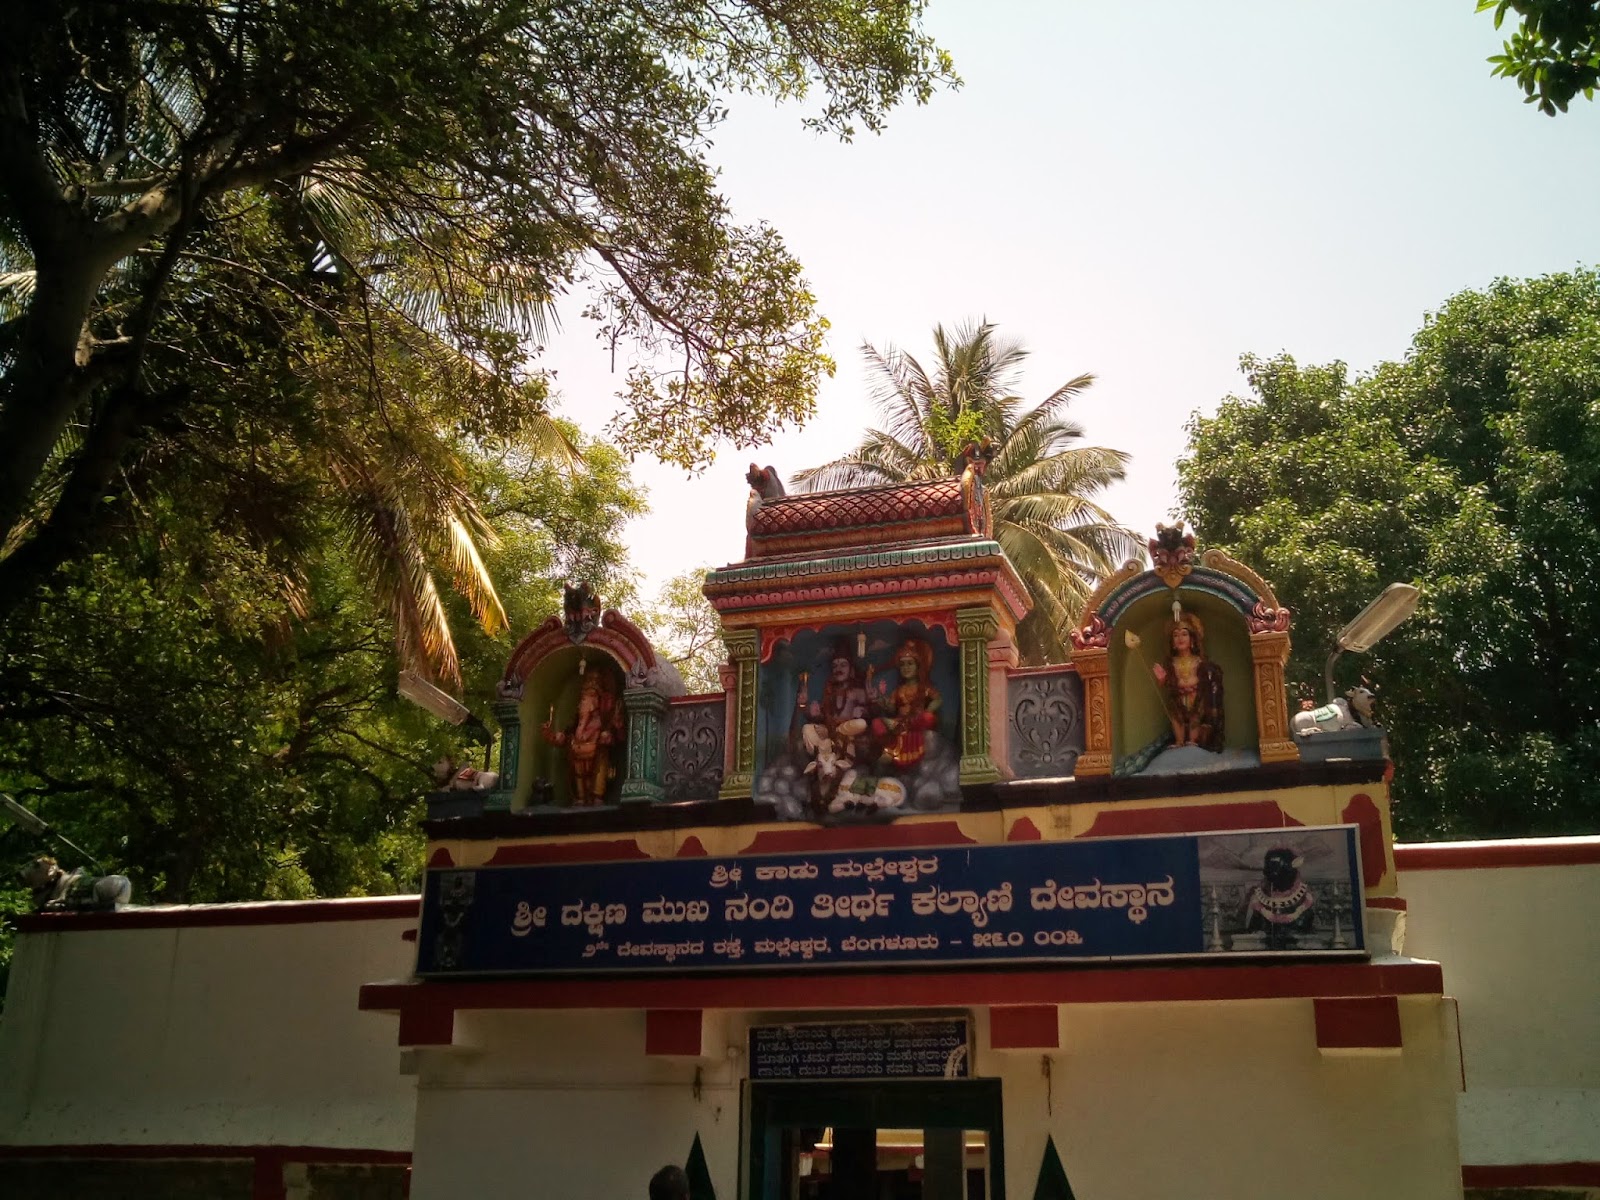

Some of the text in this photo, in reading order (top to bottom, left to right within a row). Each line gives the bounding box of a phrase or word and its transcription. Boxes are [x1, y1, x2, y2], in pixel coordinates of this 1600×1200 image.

[709, 856, 938, 888] ಶ್ರೀ ಕಾಡು ಮಲ್ಲೇಶ್ವರ
[510, 874, 1175, 937] ಶ್ರೀ ದಕ್ಷಿಣ ಮುಖ ನಂದಿ ತೀರ್ಥ ಕಲ್ಯಾಣಿ ದೇವಸ್ಥಾನ
[617, 940, 705, 963] ದೇವಸ್ಥಾನದ
[841, 933, 939, 952] ಬೆಂಗಳೂರು
